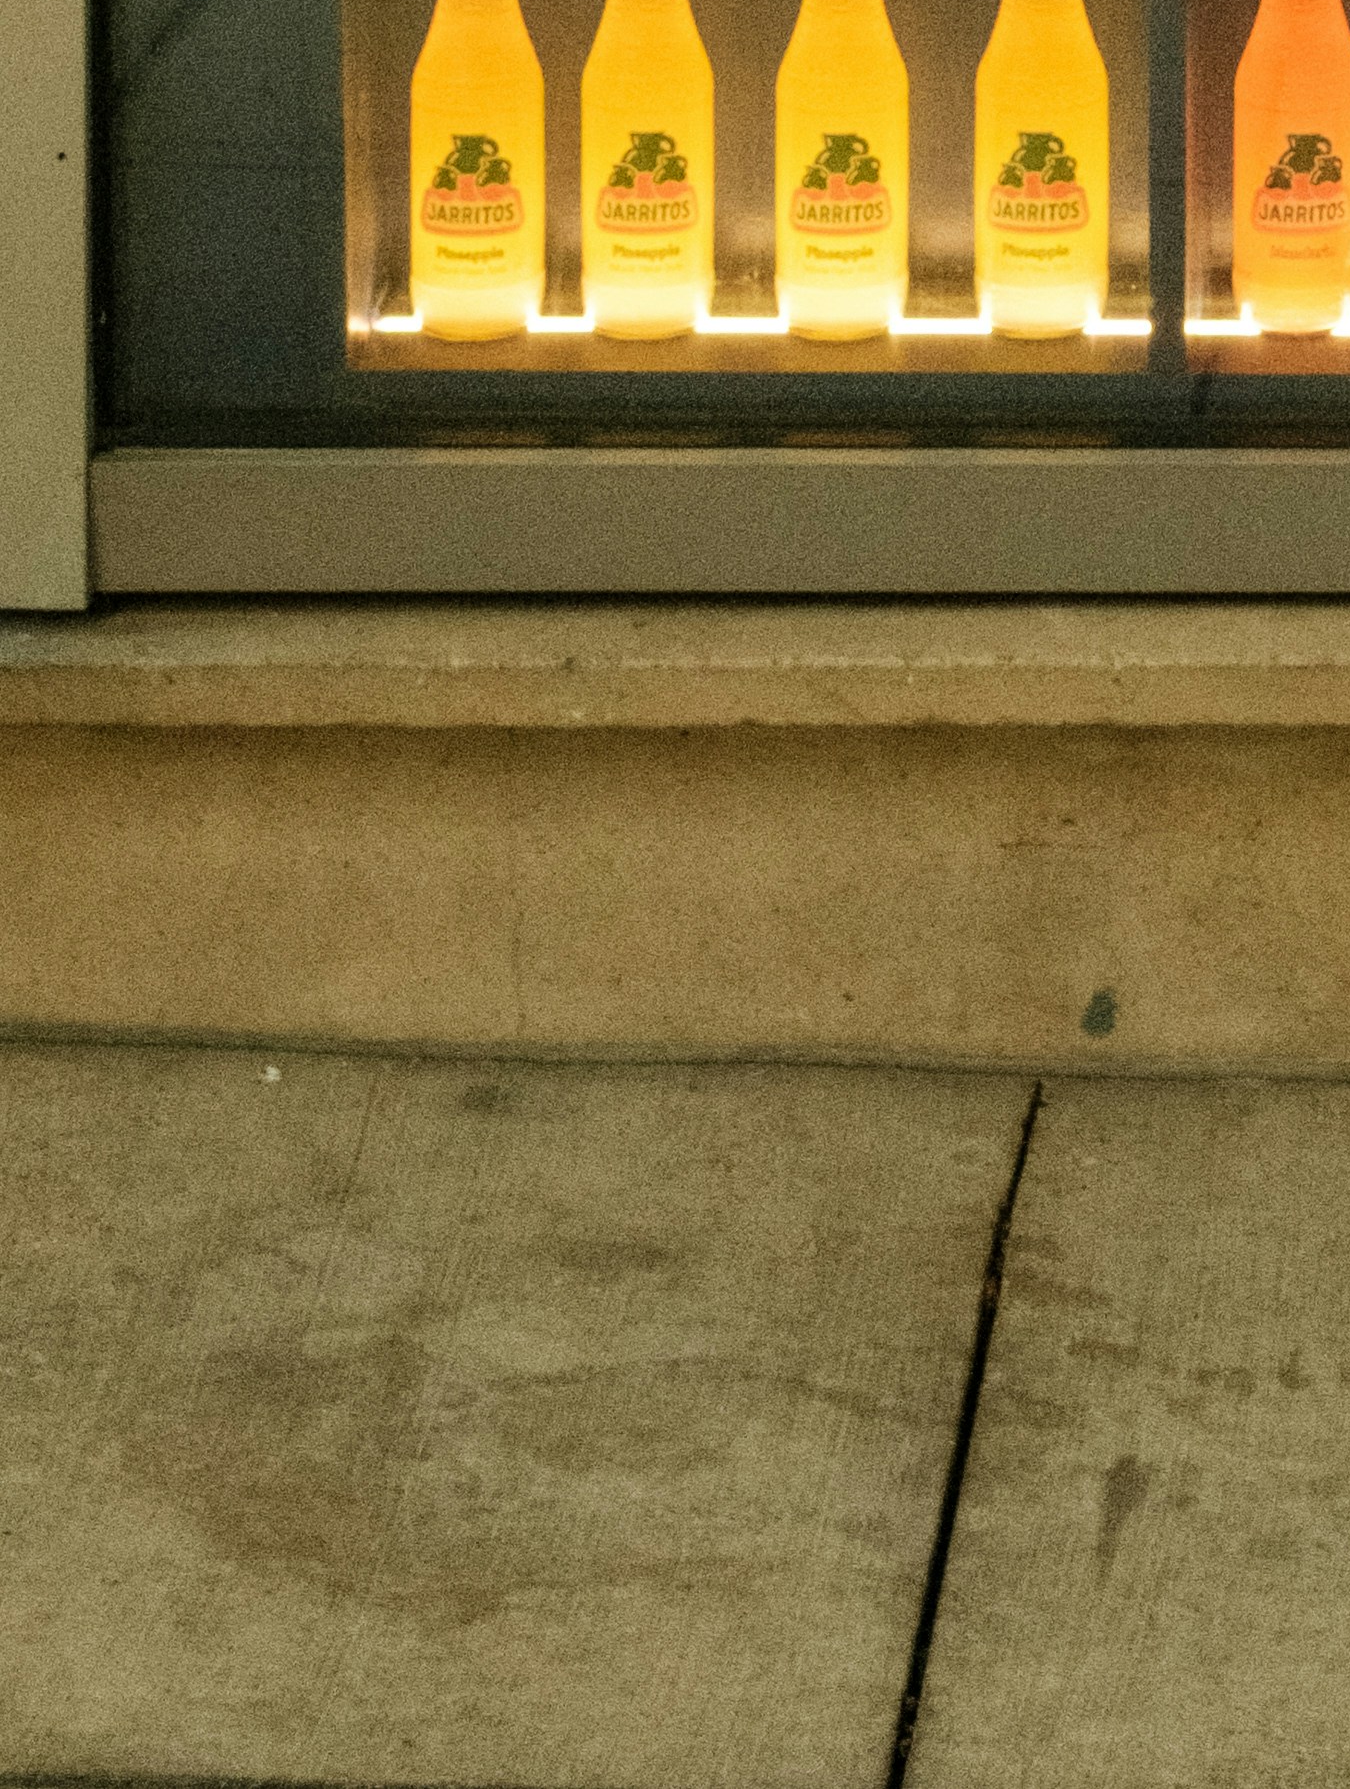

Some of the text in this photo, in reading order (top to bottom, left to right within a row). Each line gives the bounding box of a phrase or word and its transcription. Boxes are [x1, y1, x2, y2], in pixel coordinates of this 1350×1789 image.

[428, 203, 514, 224] JARRITOS
[602, 200, 689, 220] JARRITOS
[797, 202, 883, 222] JARRITOS
[994, 201, 1079, 221] JARRITOS
[1259, 201, 1344, 223] JARRITOS
[437, 246, 504, 262] Pineapple
[612, 244, 680, 259] Pineapple
[806, 246, 874, 261] Pineapple
[1002, 244, 1069, 260] Pineapple
